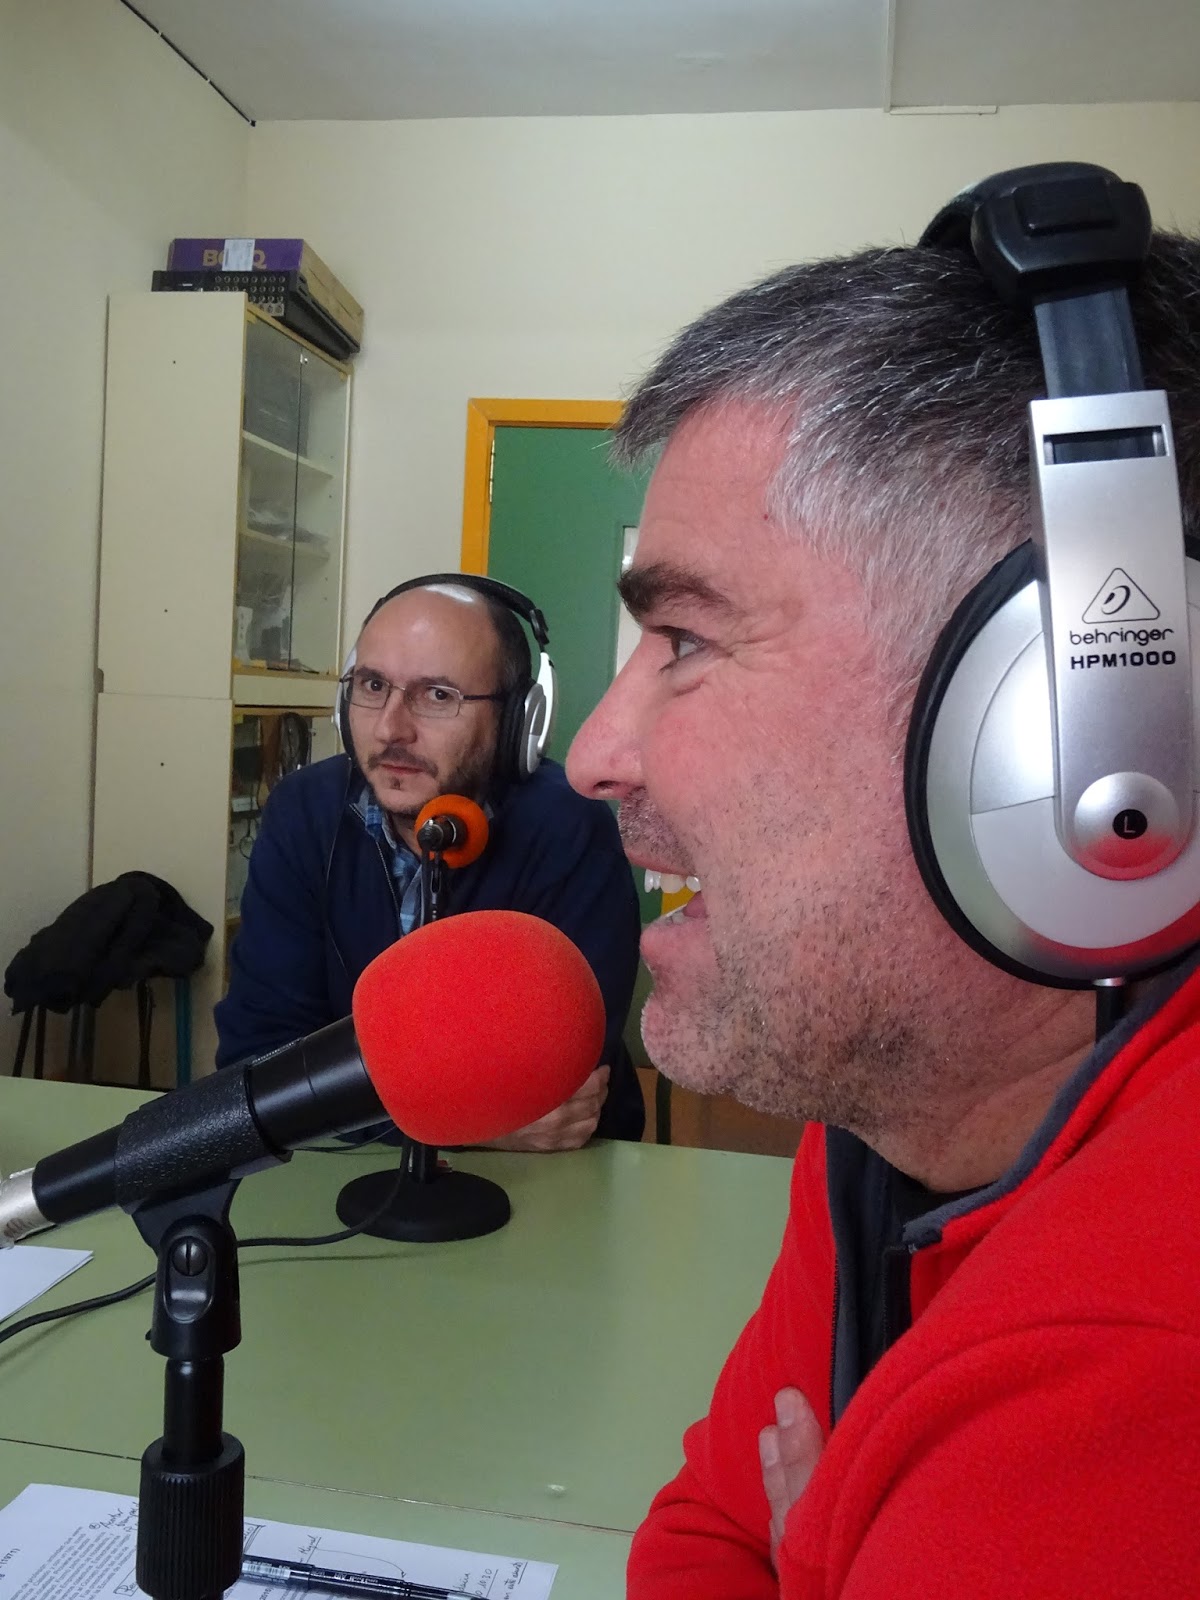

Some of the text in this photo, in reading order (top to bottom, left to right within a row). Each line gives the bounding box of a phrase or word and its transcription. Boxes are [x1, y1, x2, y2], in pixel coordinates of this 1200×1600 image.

[203, 249, 267, 269] BQ
[1070, 627, 1175, 646] behringer
[1071, 651, 1176, 669] HPM1000
[1123, 815, 1137, 833] L
